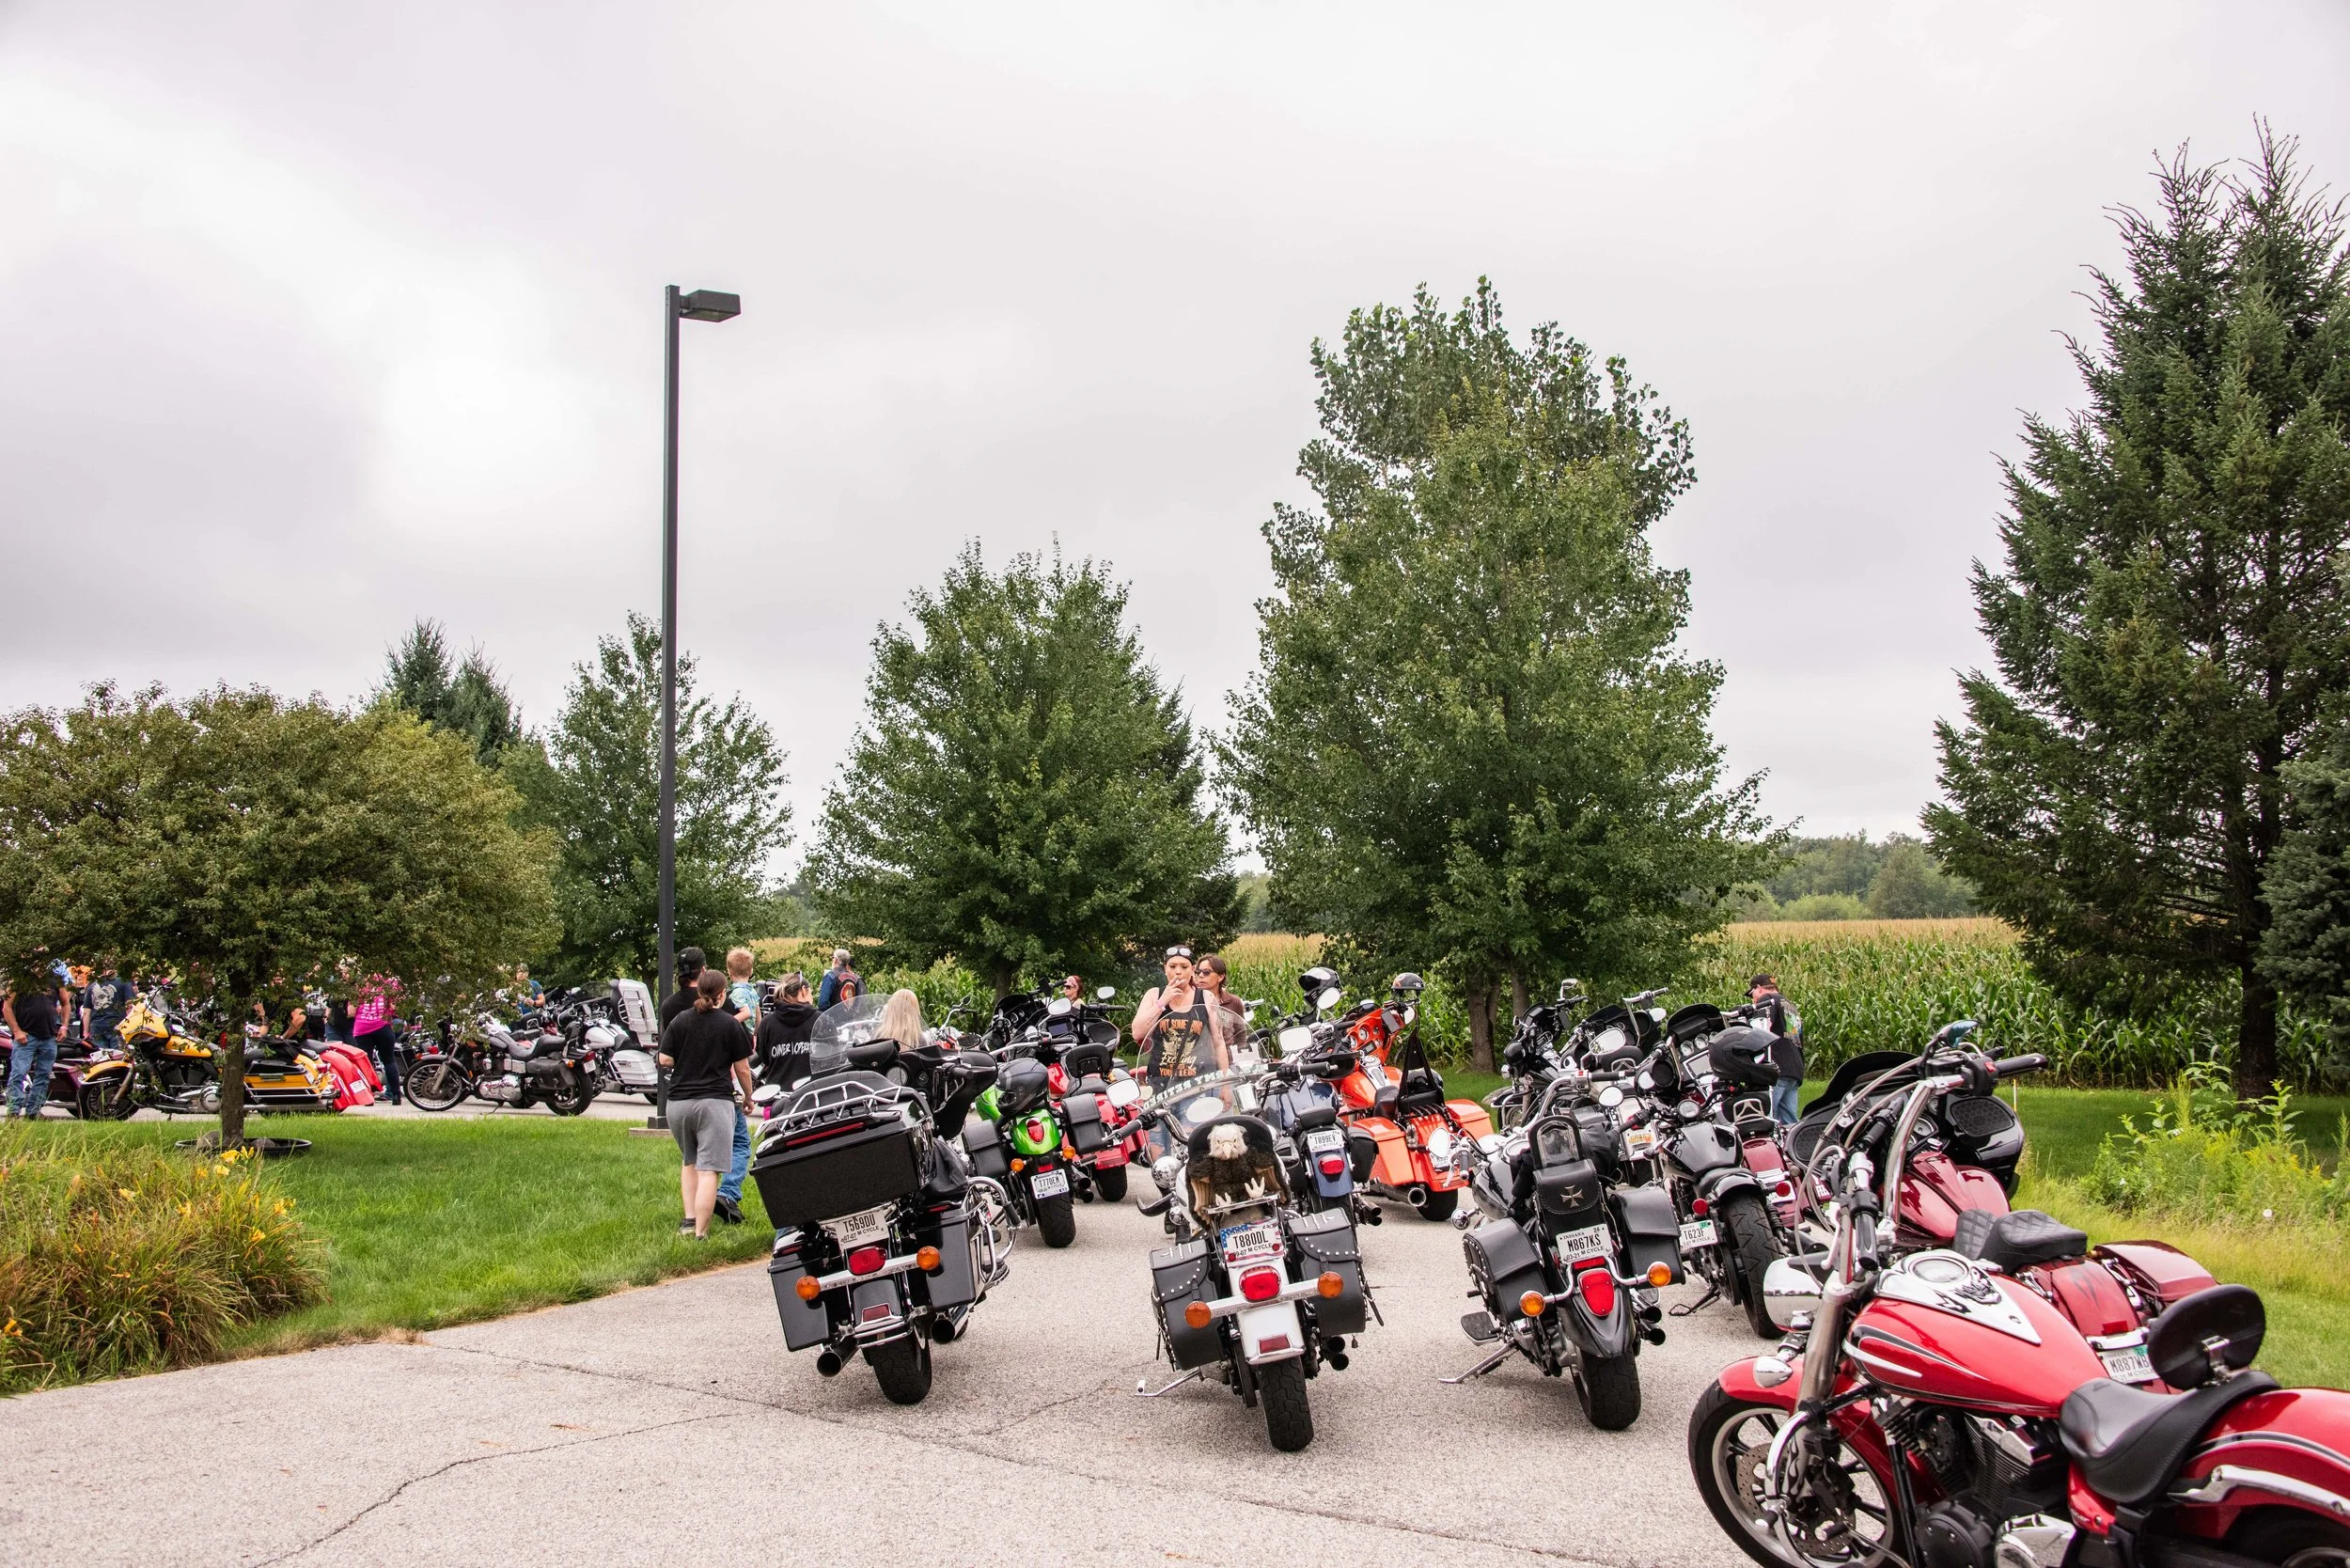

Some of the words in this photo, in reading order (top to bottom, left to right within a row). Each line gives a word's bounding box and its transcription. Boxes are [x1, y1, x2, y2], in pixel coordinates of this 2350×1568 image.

[842, 1213, 876, 1232] T569DU
[862, 1225, 880, 1234] CYCLE
[1232, 1230, 1269, 1249] T880DL
[1253, 1242, 1273, 1251] CYCLE
[1567, 1233, 1602, 1252] M867KS
[1586, 1245, 1605, 1254] CYCLE
